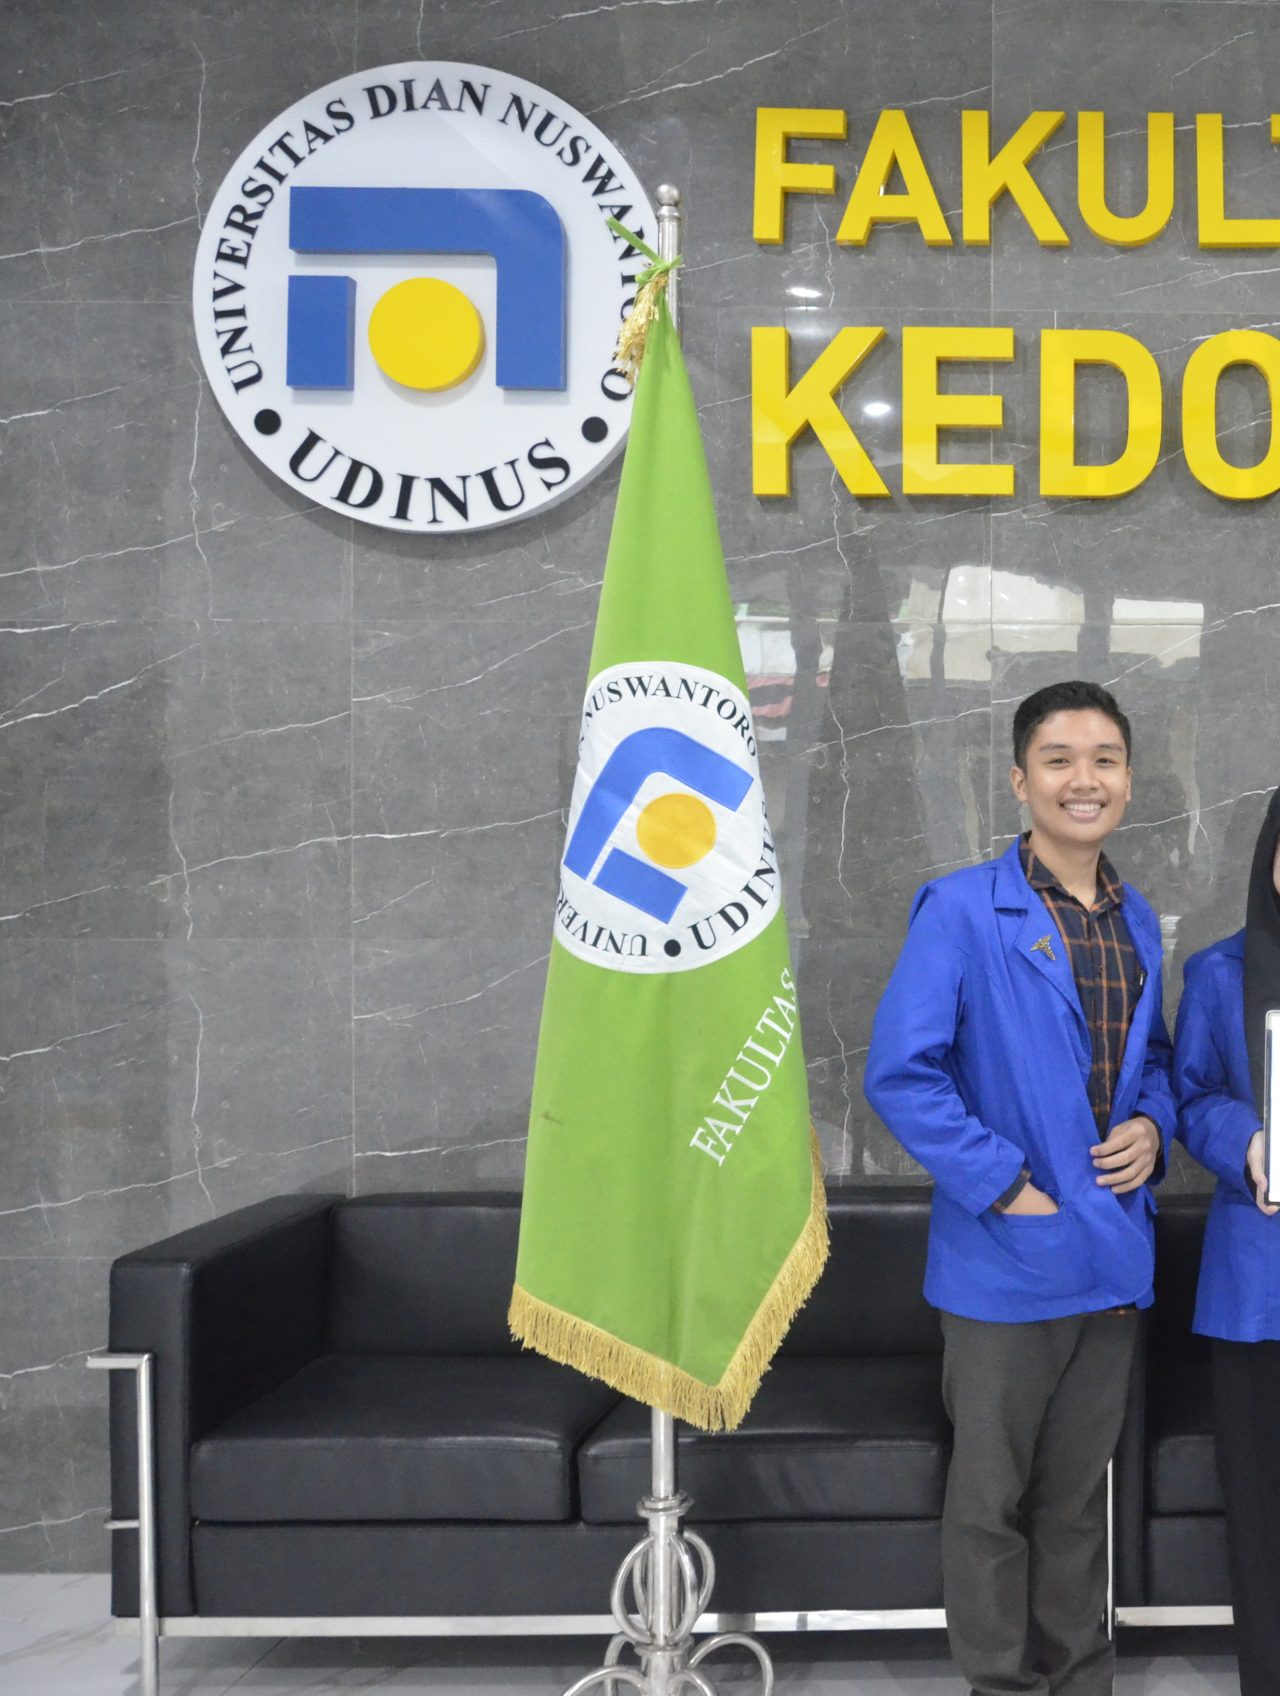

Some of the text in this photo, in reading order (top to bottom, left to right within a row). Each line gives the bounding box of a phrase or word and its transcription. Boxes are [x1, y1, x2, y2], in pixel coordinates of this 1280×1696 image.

[212, 77, 648, 402] UNIVERSITAS DIAN NUSWANO
[287, 427, 572, 525] UDINUS
[556, 884, 649, 957] UNIVER
[689, 967, 797, 1167] FAKULTAS
